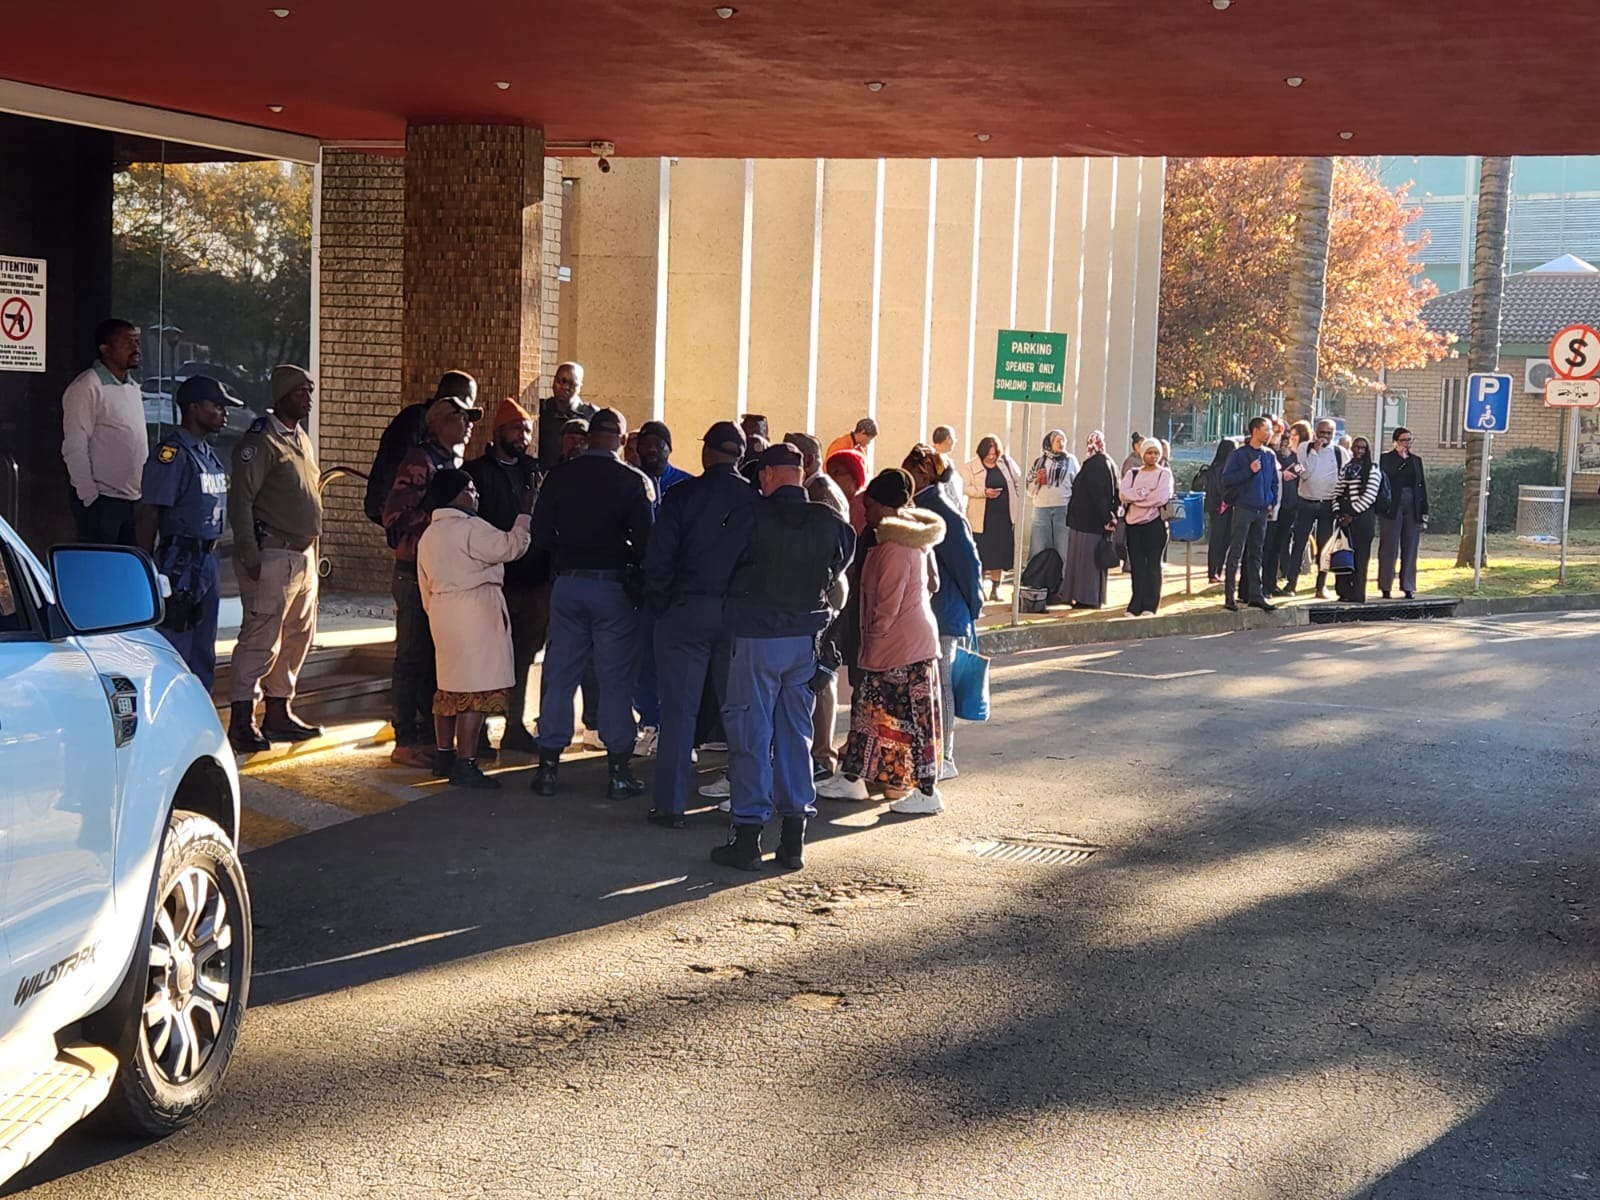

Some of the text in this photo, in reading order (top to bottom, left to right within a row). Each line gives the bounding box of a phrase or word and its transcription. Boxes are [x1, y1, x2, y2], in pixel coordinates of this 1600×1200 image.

[0, 261, 39, 274] TTENTION
[1011, 341, 1052, 355] PARKING
[1565, 339, 1588, 367] S
[1005, 361, 1055, 374] SPEAKER ONLY
[1479, 377, 1500, 401] P
